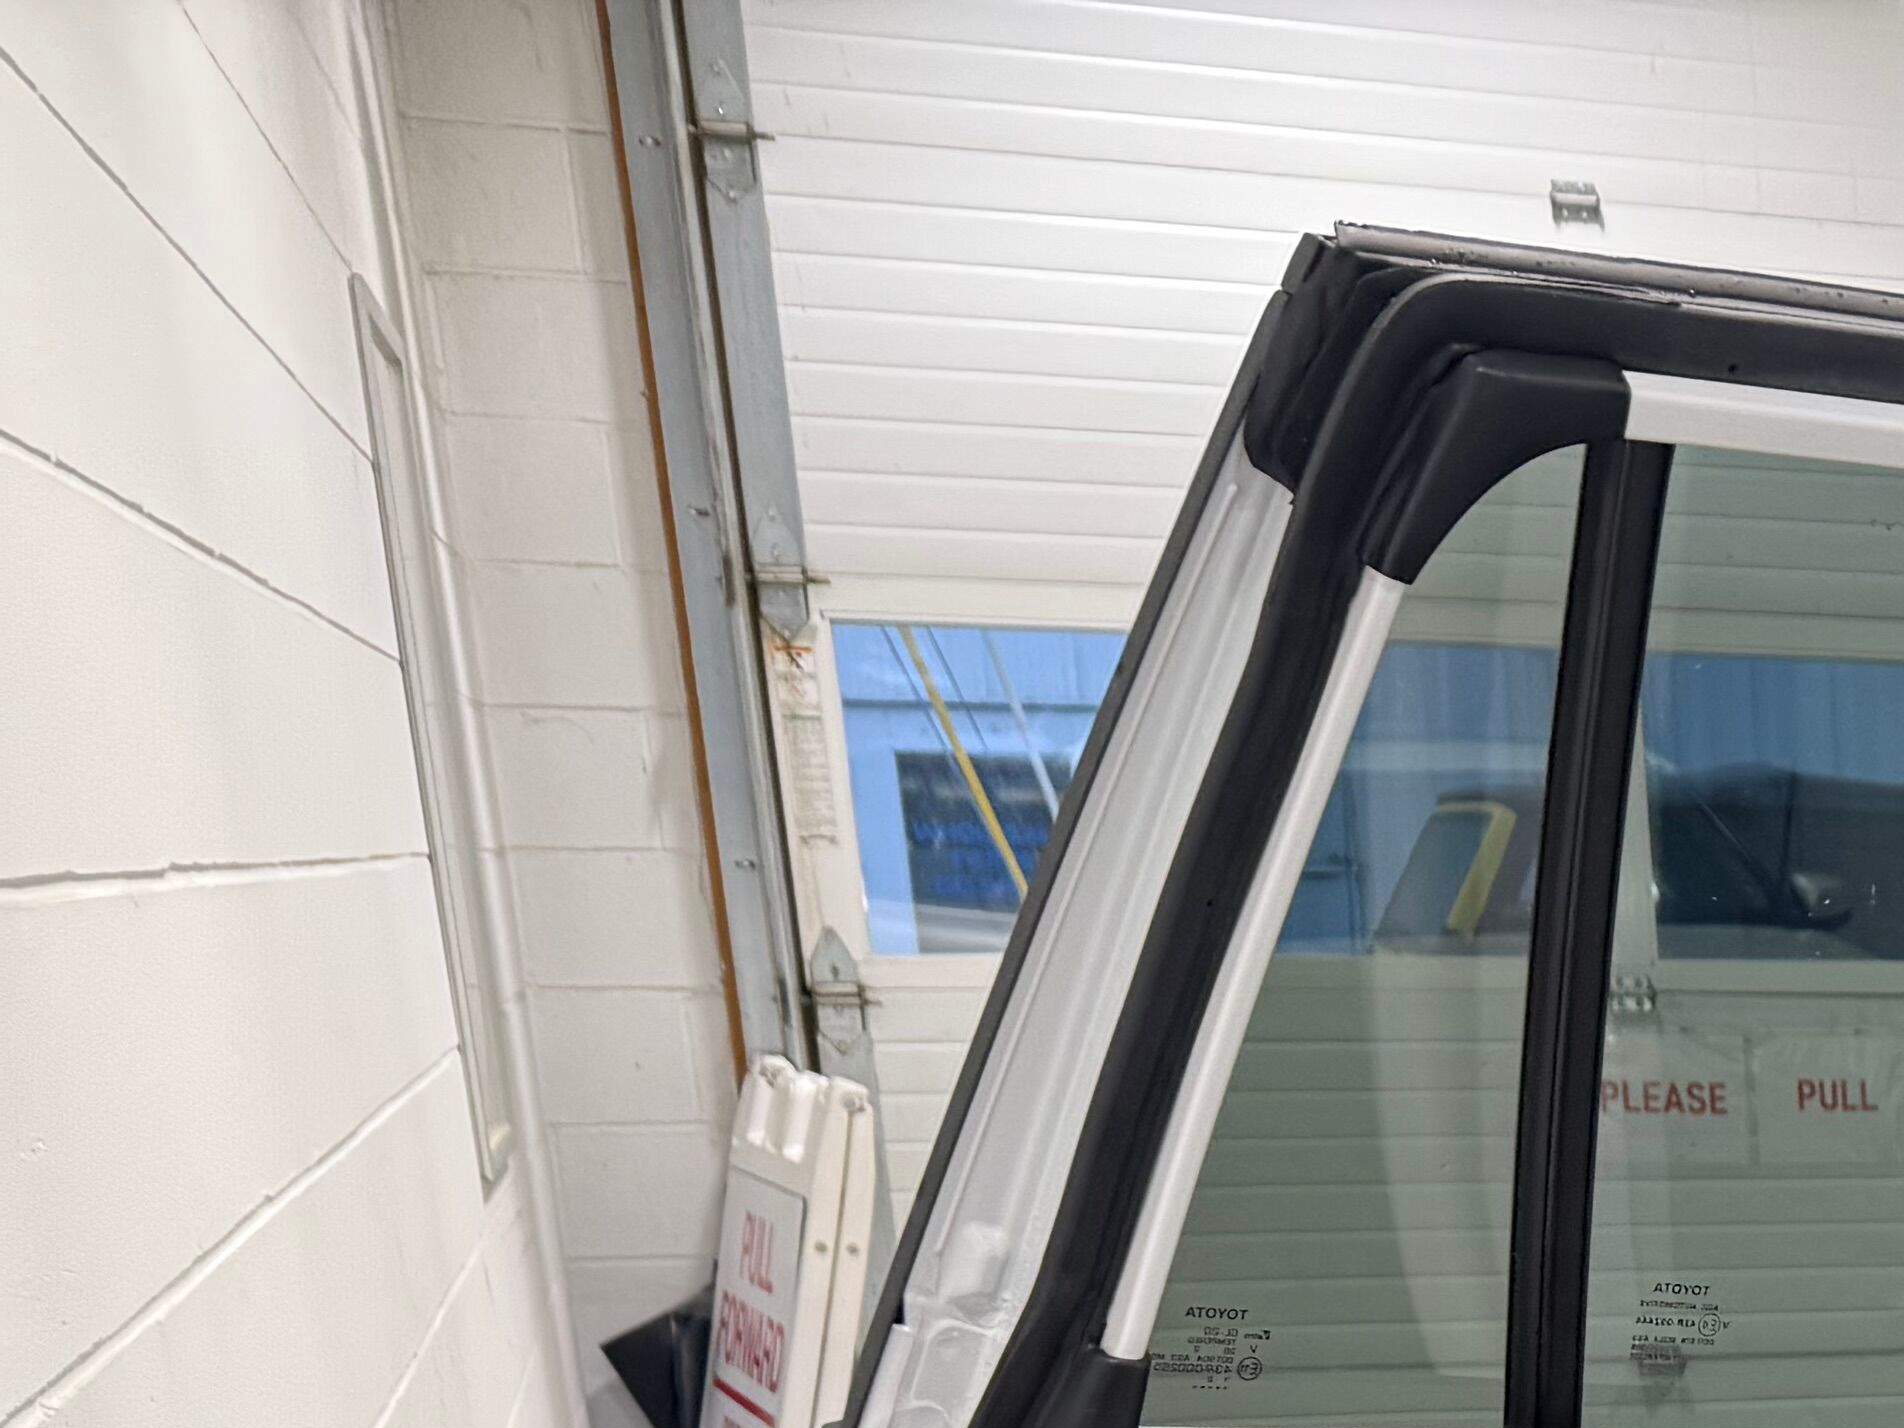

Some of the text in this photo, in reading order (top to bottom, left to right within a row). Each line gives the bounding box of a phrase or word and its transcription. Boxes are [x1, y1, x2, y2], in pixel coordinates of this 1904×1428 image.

[1600, 1079, 1728, 1116] PLEASE
[1797, 1078, 1879, 1112] PULL
[739, 1210, 774, 1294] PULL
